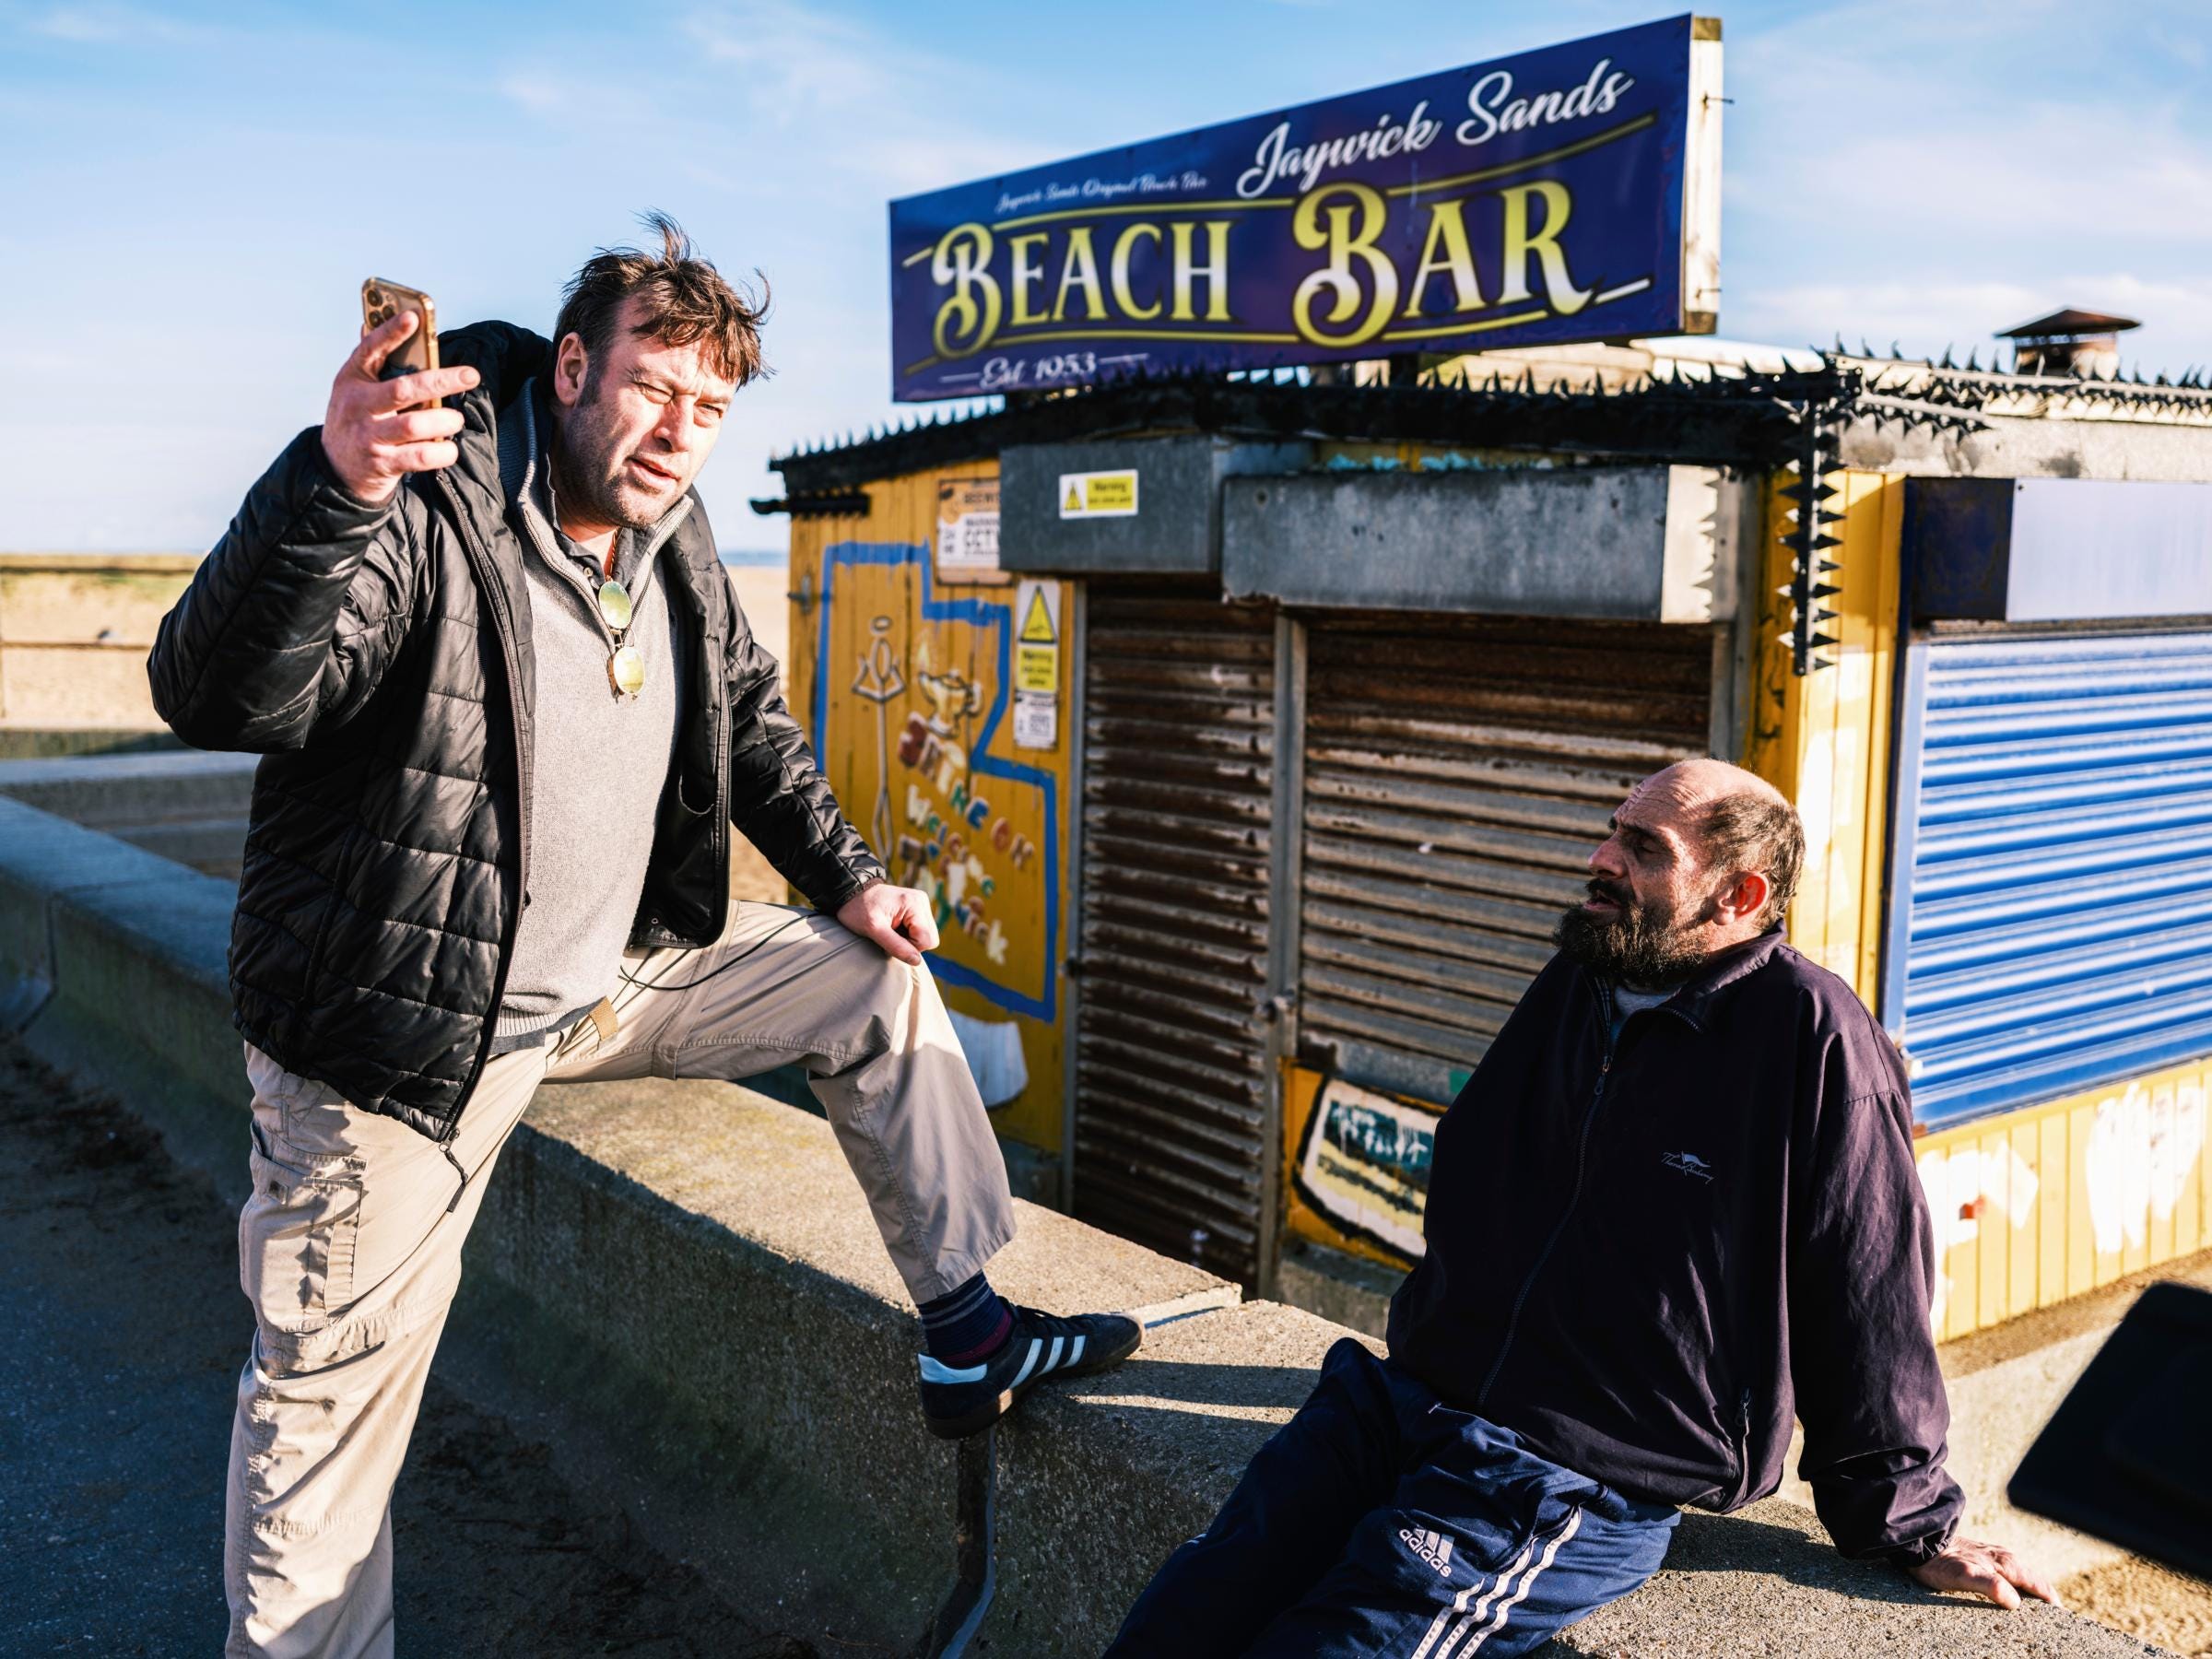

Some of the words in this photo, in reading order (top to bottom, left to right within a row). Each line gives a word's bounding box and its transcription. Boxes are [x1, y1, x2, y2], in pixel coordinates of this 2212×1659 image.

[1236, 100, 1442, 198] Jaywick
[1455, 58, 1635, 146] Sands
[931, 220, 1232, 359] BEACH
[1292, 180, 1594, 347] BAR
[1033, 351, 1097, 381] 1953
[1399, 1529, 1452, 1577] adidas
